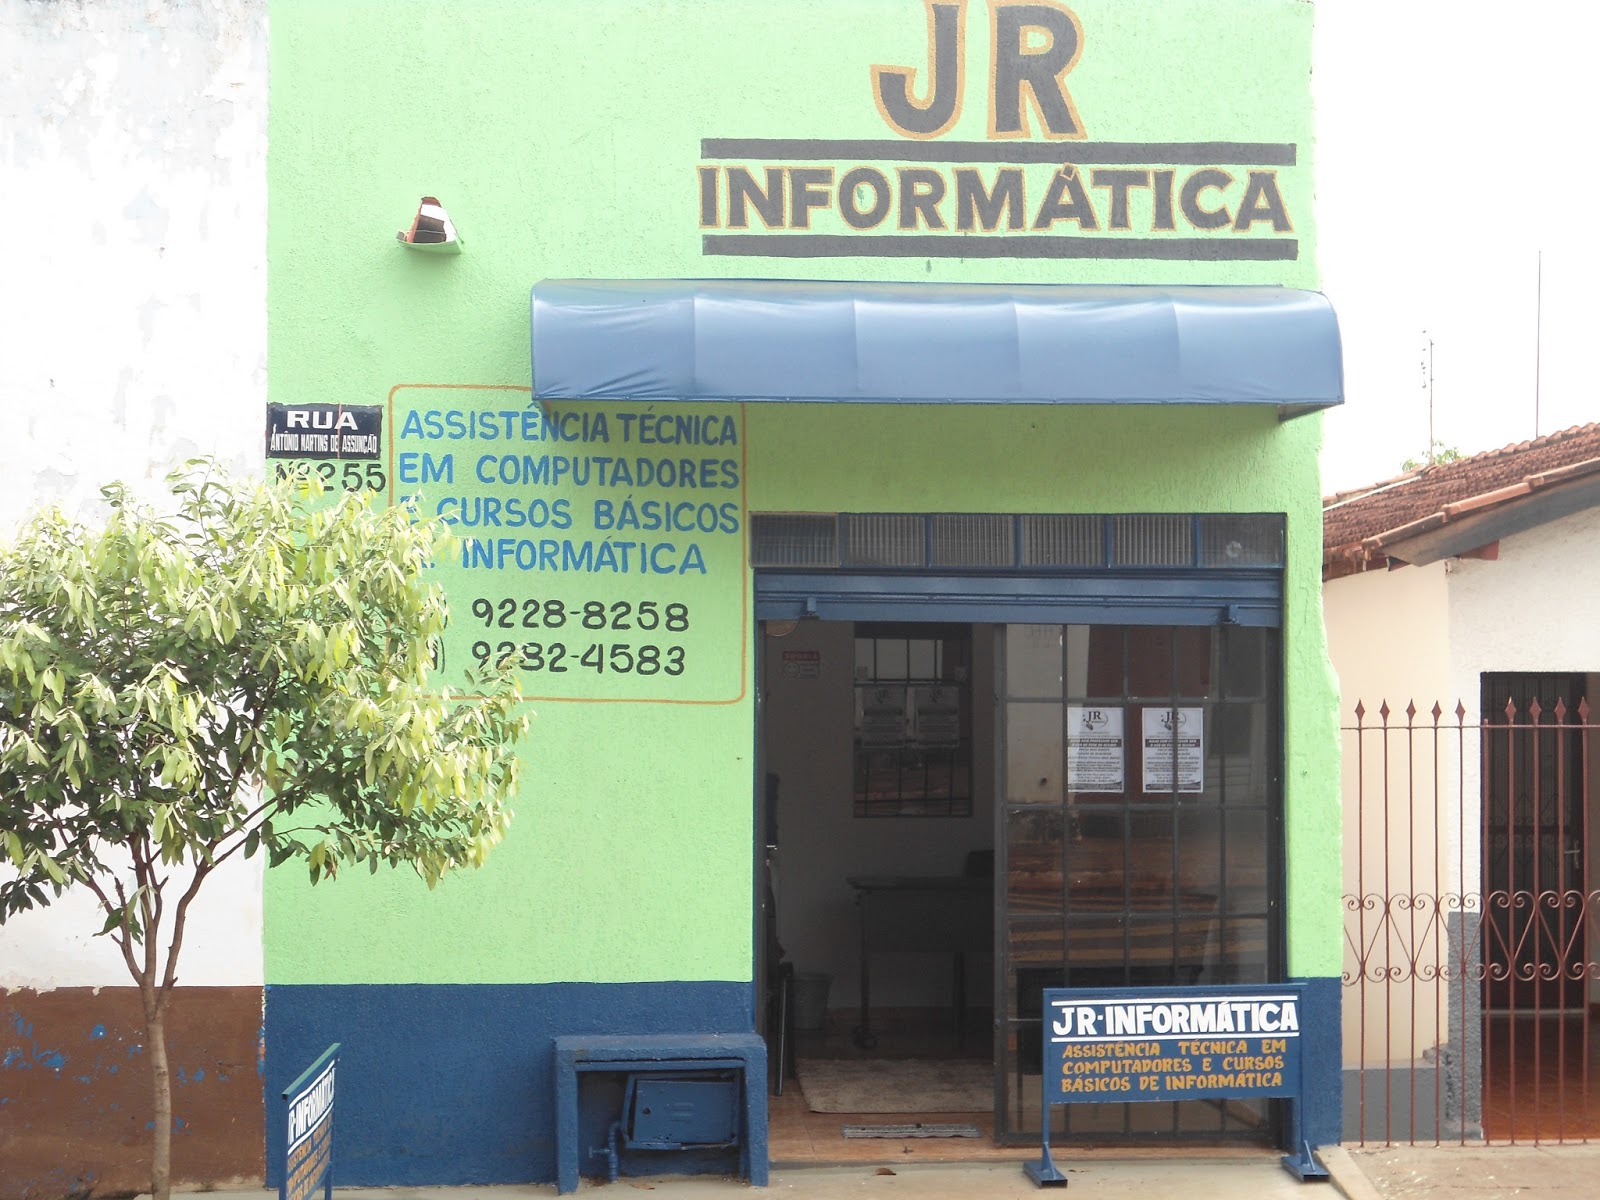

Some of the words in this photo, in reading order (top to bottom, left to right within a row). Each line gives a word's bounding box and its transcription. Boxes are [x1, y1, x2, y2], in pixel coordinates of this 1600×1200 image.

[869, 0, 1088, 140] JR
[697, 162, 1294, 233] INFORMÁTICA
[287, 410, 359, 430] RUA
[400, 402, 610, 443] ASSISTÊNCIA
[615, 405, 738, 446] TÉCNICA
[300, 434, 328, 452] MARTINS
[330, 434, 339, 453] DE
[399, 452, 453, 484] EM
[476, 455, 740, 489] COMPUTADORES
[436, 496, 573, 530] CURSOS
[593, 494, 740, 534] BÁSICOS
[462, 535, 707, 576] INFORMÁTICA
[472, 598, 690, 632] 9228-8258
[1085, 711, 1102, 723] JR
[1062, 1041, 1160, 1058] ASSISTÊNCIA
[1178, 1039, 1248, 1056] TÉCNICA
[1261, 1039, 1287, 1054] EM
[1062, 1058, 1193, 1075] COMPUTADORES
[1202, 1057, 1212, 1072] E
[1222, 1056, 1285, 1071] CURSOS
[1061, 1075, 1132, 1093] BÁSICOS
[1139, 1075, 1160, 1091] DE
[1165, 1070, 1283, 1090] INFORMÁTICA
